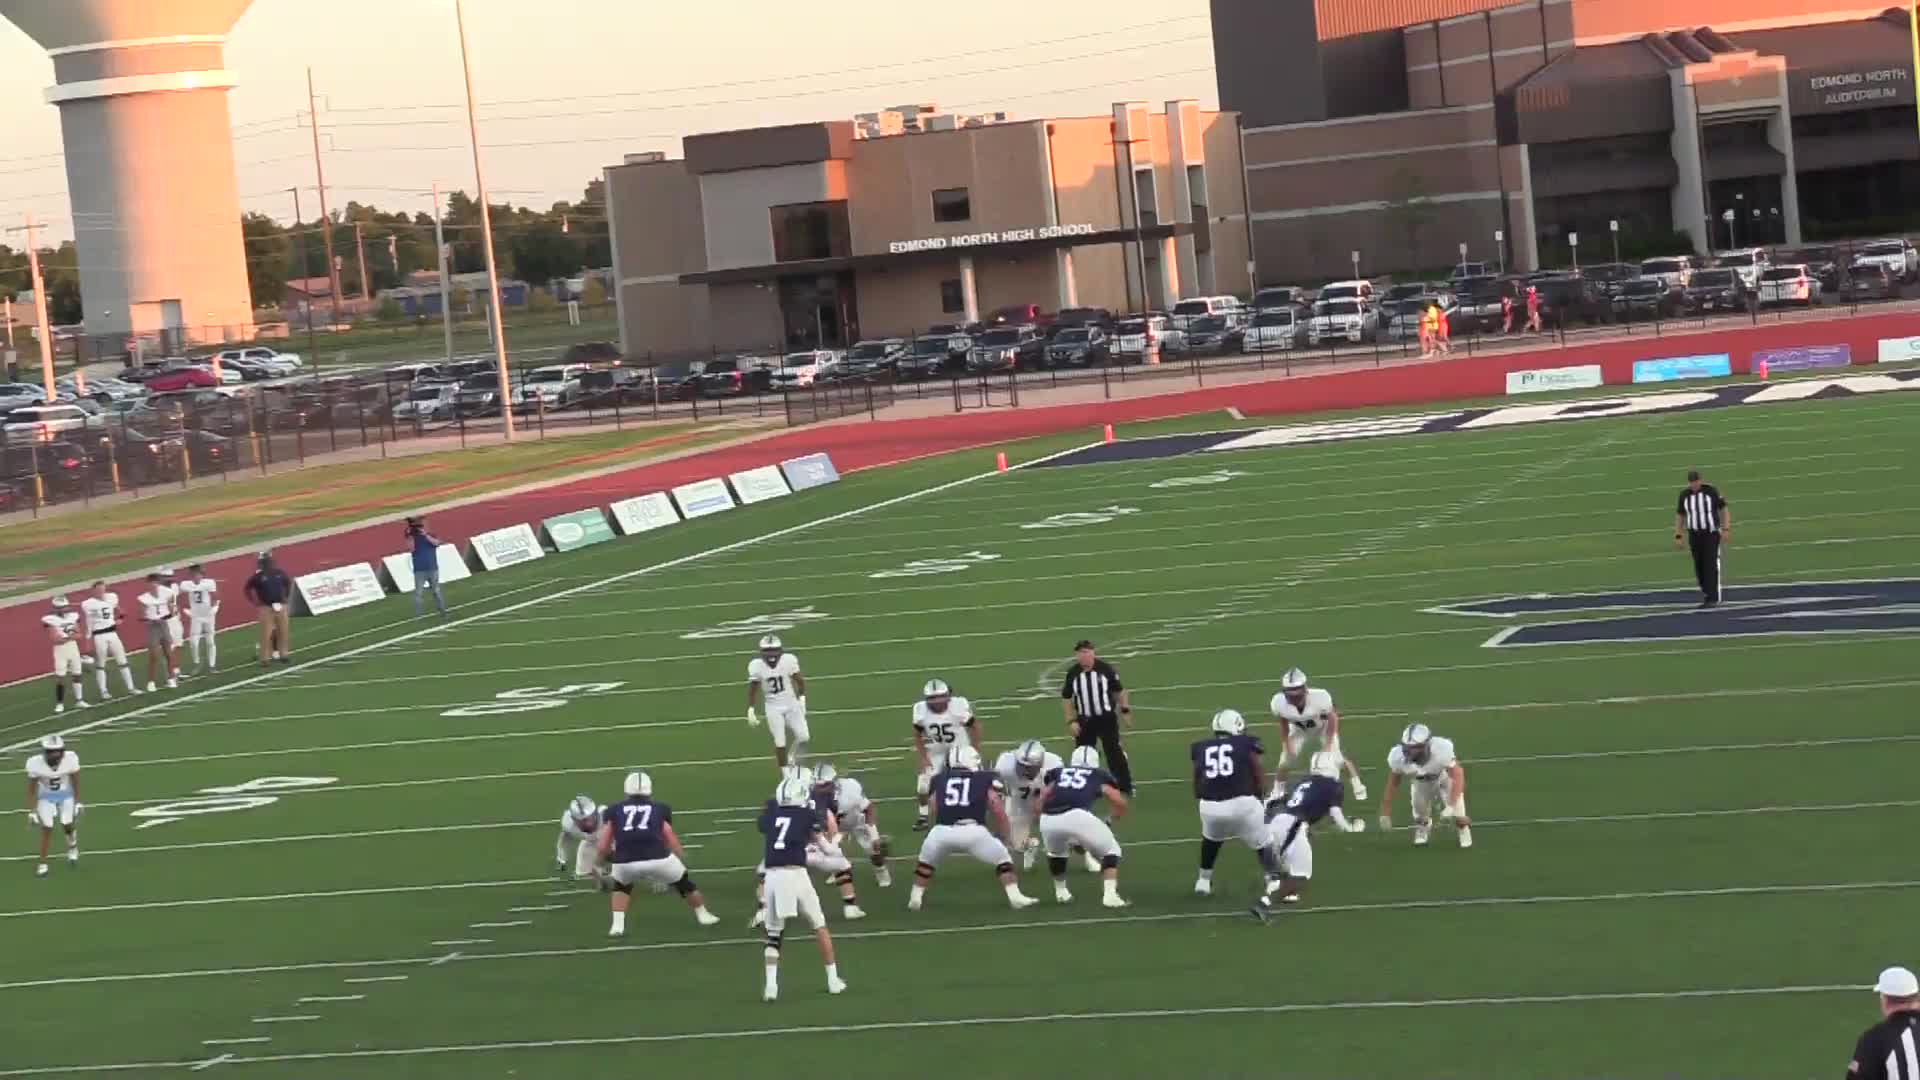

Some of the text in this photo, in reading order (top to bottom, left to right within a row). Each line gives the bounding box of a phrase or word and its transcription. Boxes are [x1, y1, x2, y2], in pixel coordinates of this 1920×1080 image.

[1810, 68, 1906, 90] EDMOND NORTH
[1825, 87, 1897, 105] AUDITORIUM
[888, 223, 1096, 253] EDMOND NORTH HIGH SCHOOL
[767, 675, 786, 694] 31
[928, 723, 956, 744] 35
[1204, 743, 1234, 779] 56
[49, 777, 61, 792] 5
[1058, 767, 1092, 789] 55
[944, 777, 971, 806] 51
[623, 804, 653, 831] 77
[775, 816, 793, 850] 7
